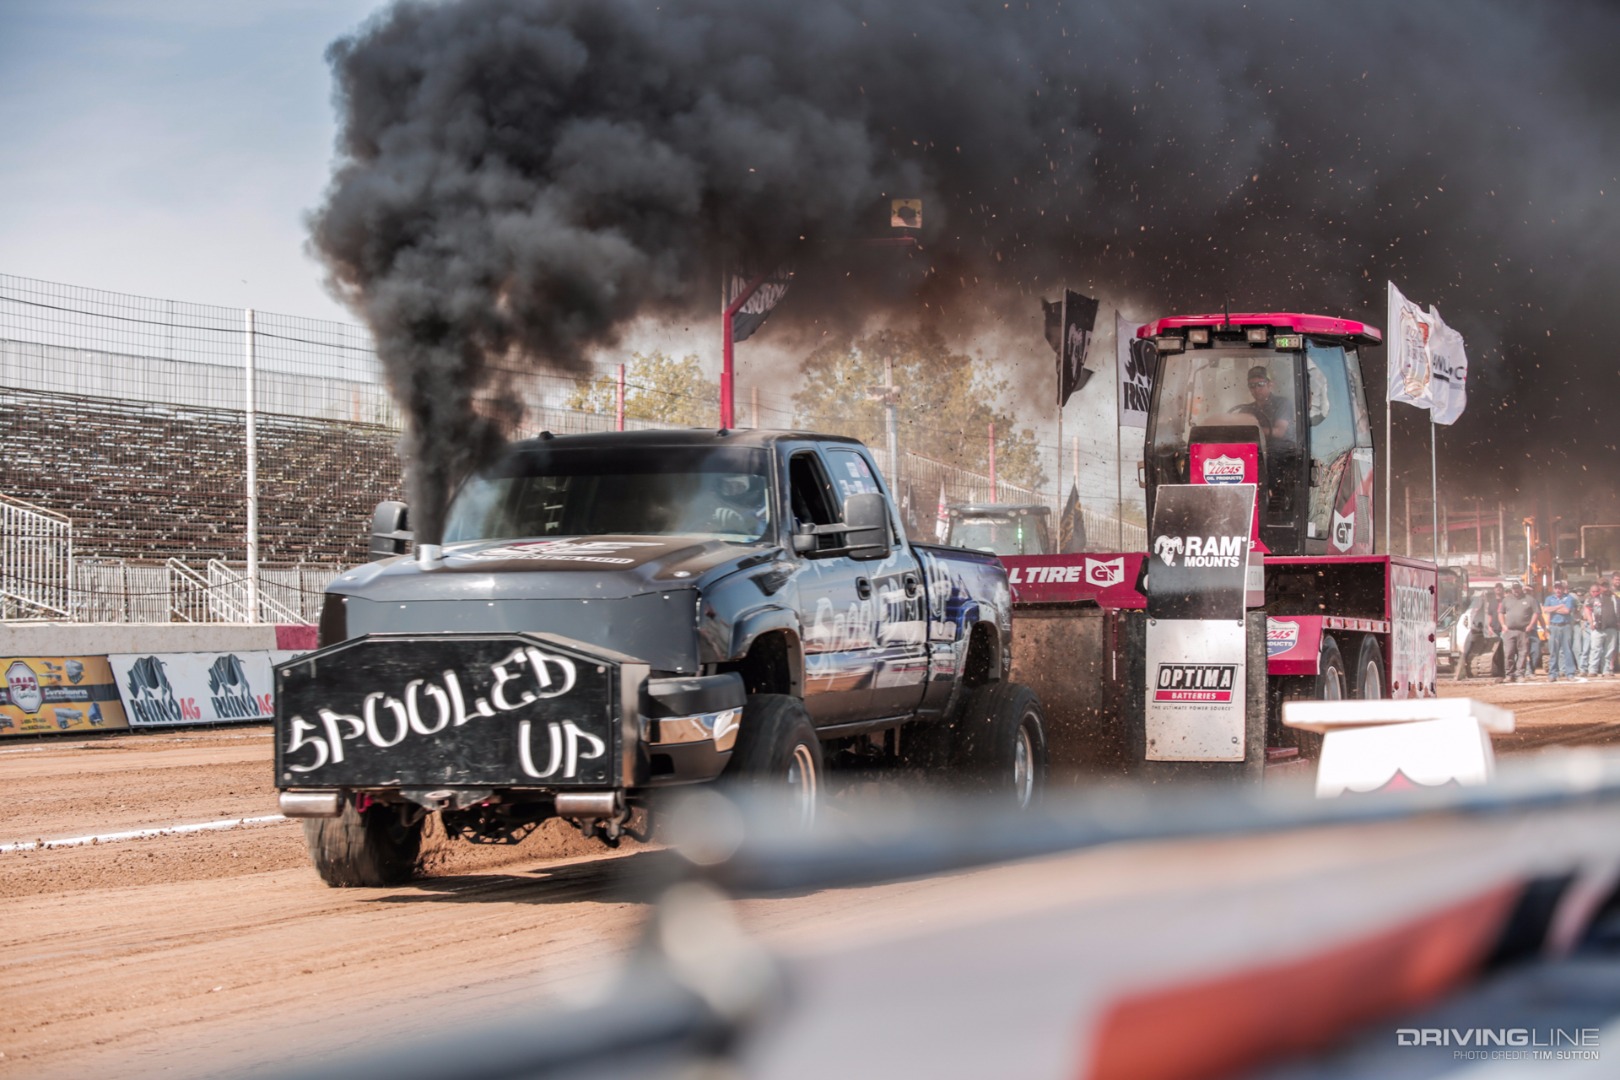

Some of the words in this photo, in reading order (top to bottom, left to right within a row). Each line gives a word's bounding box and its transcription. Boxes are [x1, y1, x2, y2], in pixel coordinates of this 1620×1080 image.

[1209, 465, 1242, 475] LUCAS
[1185, 536, 1242, 556] RAM
[1184, 556, 1240, 568] MOUNTS
[1025, 566, 1083, 583] TIRE
[1160, 668, 1232, 688] OPTIMA
[1171, 692, 1217, 701] BATTERIES
[286, 647, 576, 773] SPOOLED
[519, 719, 605, 779] UP
